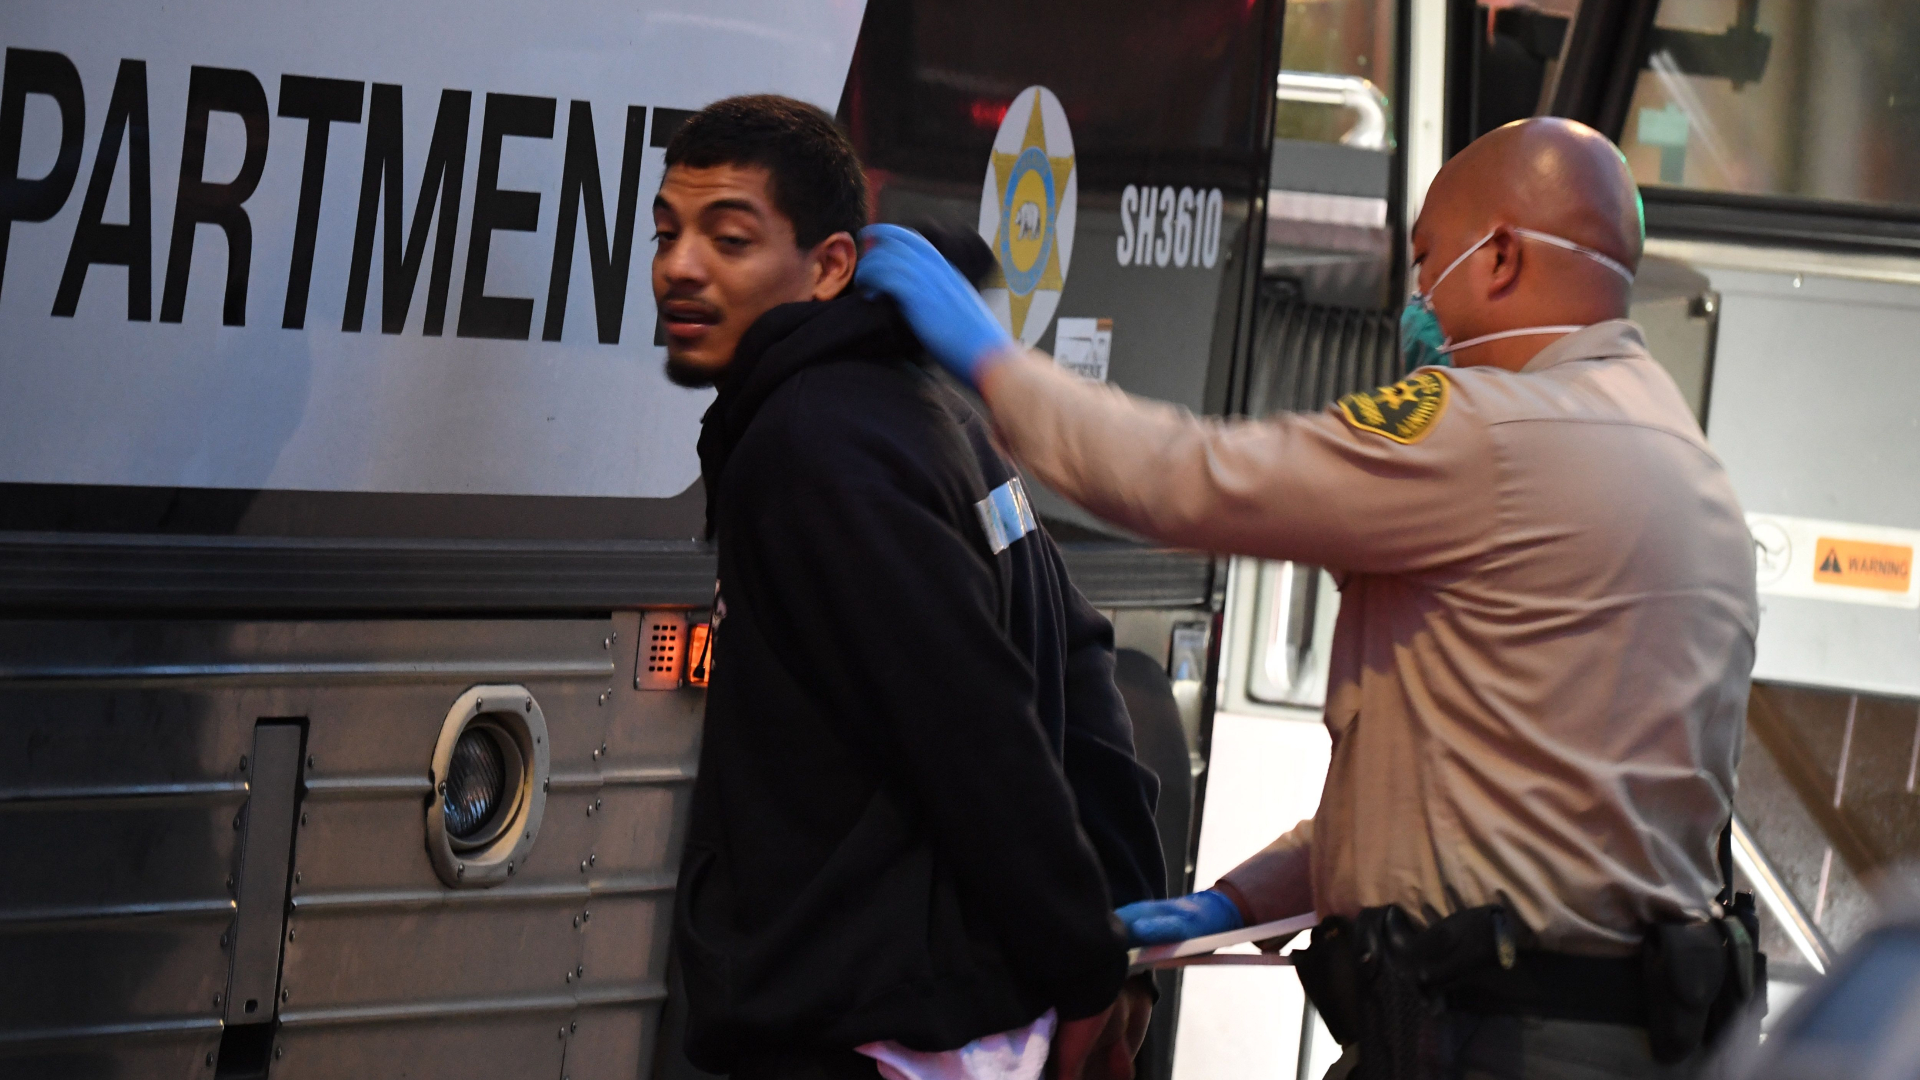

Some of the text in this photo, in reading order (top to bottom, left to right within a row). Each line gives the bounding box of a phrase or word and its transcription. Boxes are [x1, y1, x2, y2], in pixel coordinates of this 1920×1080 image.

[0, 47, 702, 346] PARTMEN
[1117, 184, 1223, 269] SH3610
[1848, 557, 1908, 577] WARNING
